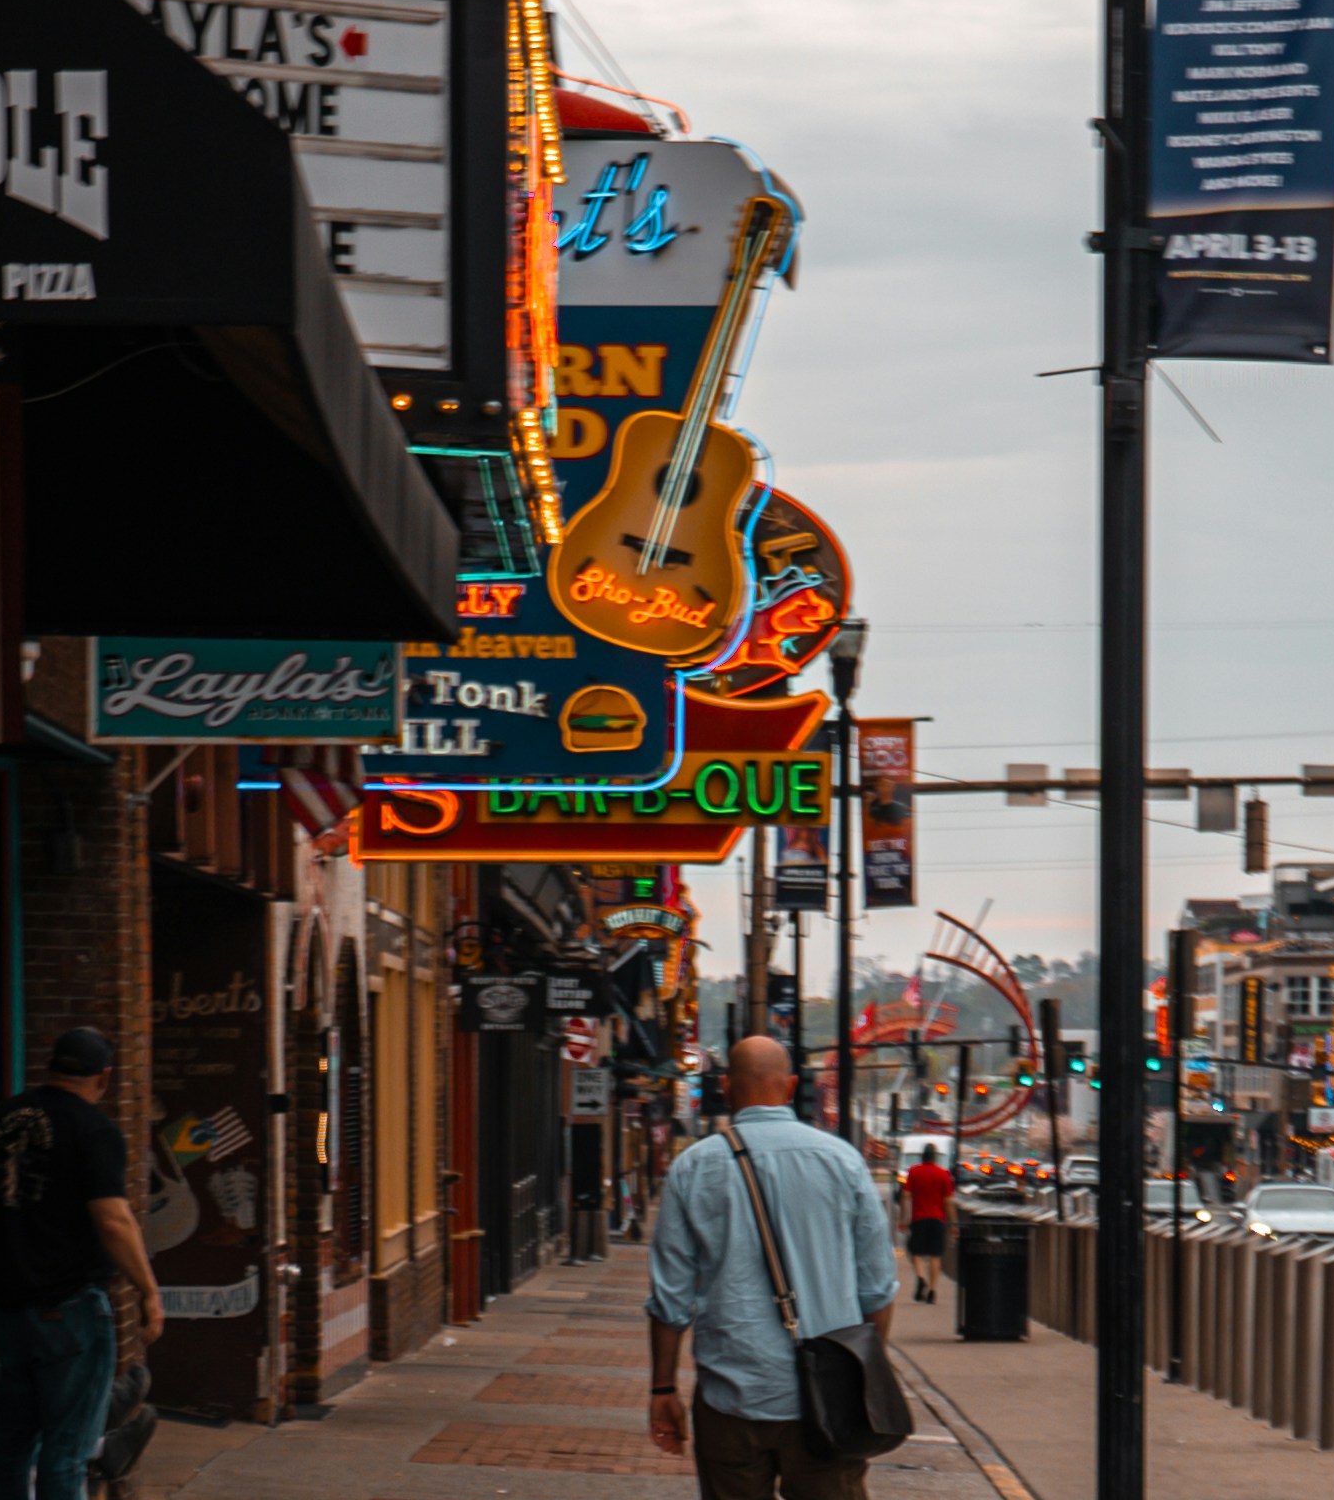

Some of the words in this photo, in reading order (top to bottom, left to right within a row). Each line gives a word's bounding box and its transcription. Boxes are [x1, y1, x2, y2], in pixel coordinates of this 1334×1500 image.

[1163, 233, 1251, 259] APRIL
[1252, 235, 1318, 262] 3-13
[2, 262, 97, 300] PIZZA
[570, 567, 717, 629] Sho-Bud
[103, 652, 390, 729] Layla's
[423, 670, 550, 718] Tonk
[487, 760, 822, 818] BAR-B-QUE
